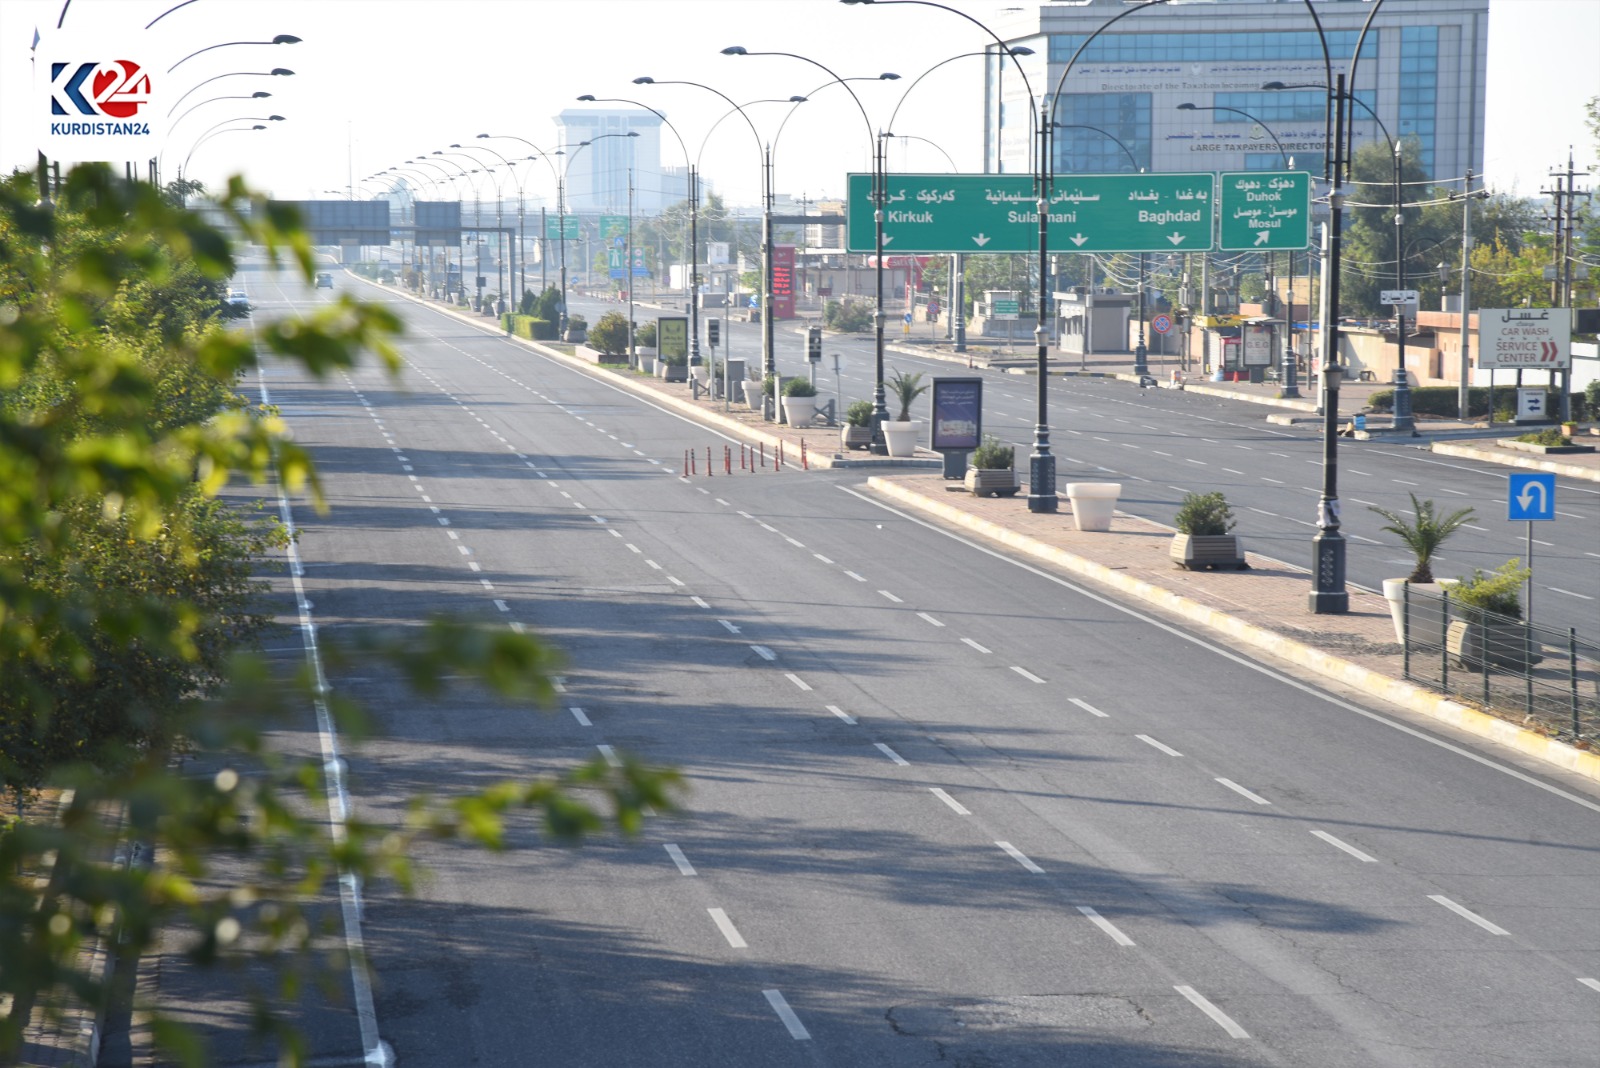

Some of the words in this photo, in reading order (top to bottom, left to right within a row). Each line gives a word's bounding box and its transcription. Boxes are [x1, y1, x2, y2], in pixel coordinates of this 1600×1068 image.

[1190, 144, 1221, 152] LARGE
[1224, 142, 1278, 152] TAXPAYERS
[1280, 142, 1347, 151] DIRECTORAE
[1246, 192, 1282, 201] Duhok
[888, 210, 933, 223] Kirkuk
[1008, 211, 1076, 223] Sulamani
[1138, 209, 1201, 225] Baghdad
[1249, 218, 1281, 228] Mosul
[1501, 309, 1549, 323] غسل
[1522, 327, 1549, 335] WASH
[1496, 341, 1537, 351] SERVICE
[1496, 353, 1536, 363] CENTER
